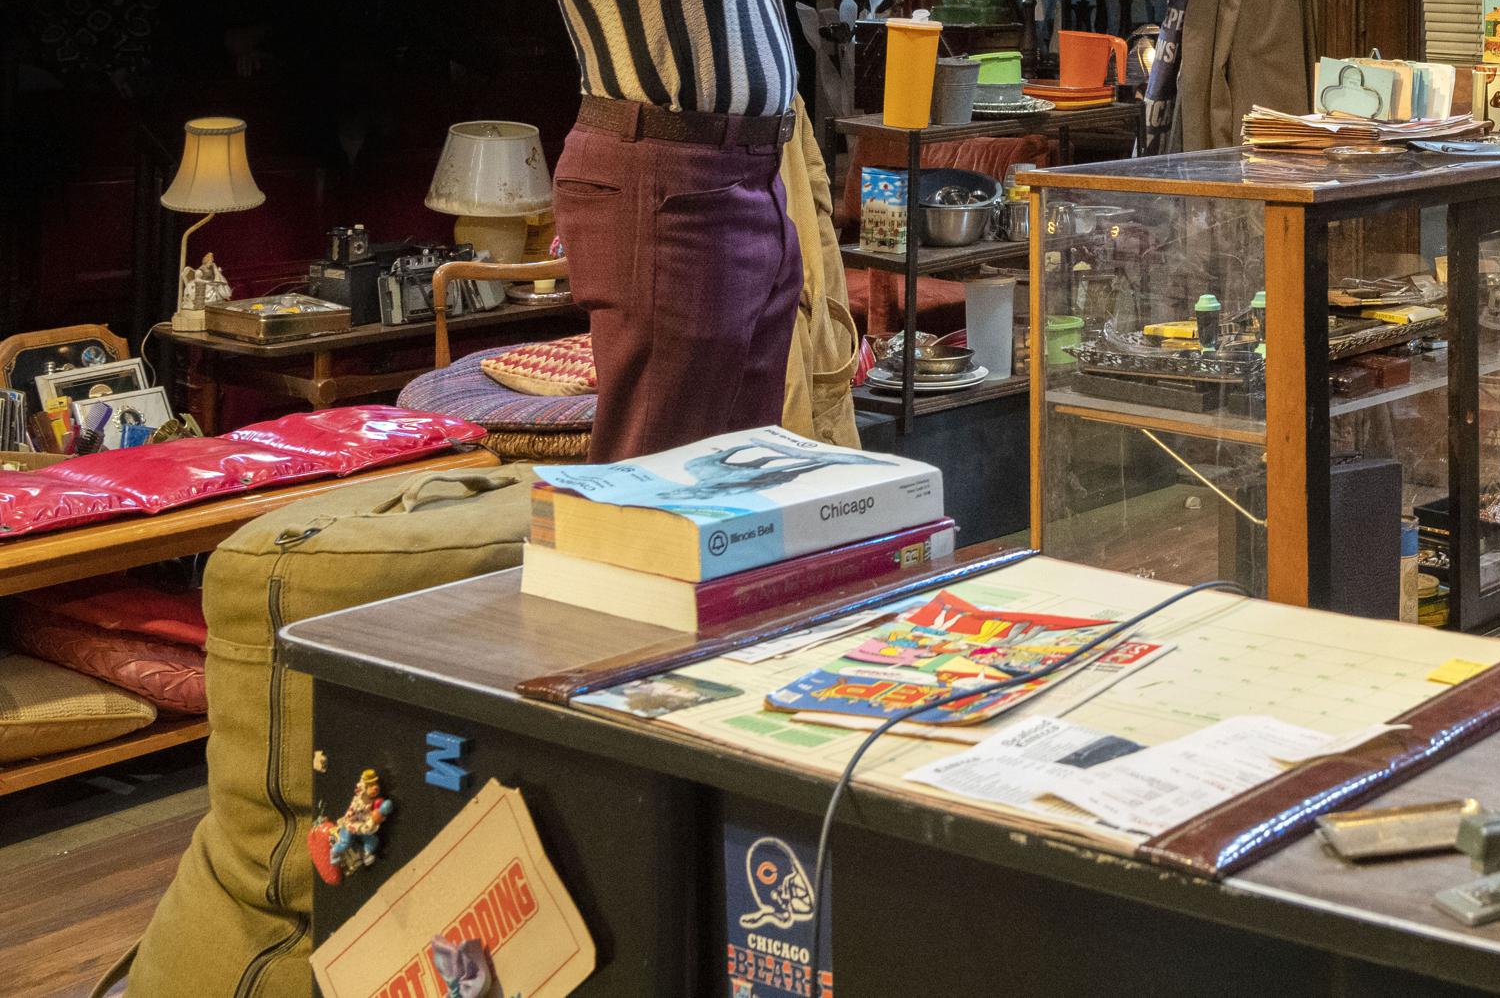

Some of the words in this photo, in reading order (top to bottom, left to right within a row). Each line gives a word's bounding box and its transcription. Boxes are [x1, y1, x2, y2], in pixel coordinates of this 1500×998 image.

[819, 496, 876, 522] Chicago
[730, 527, 756, 545] Illinois
[757, 522, 775, 539] Bell
[747, 933, 810, 964] CHICAGO
[733, 949, 822, 998] BEAR
